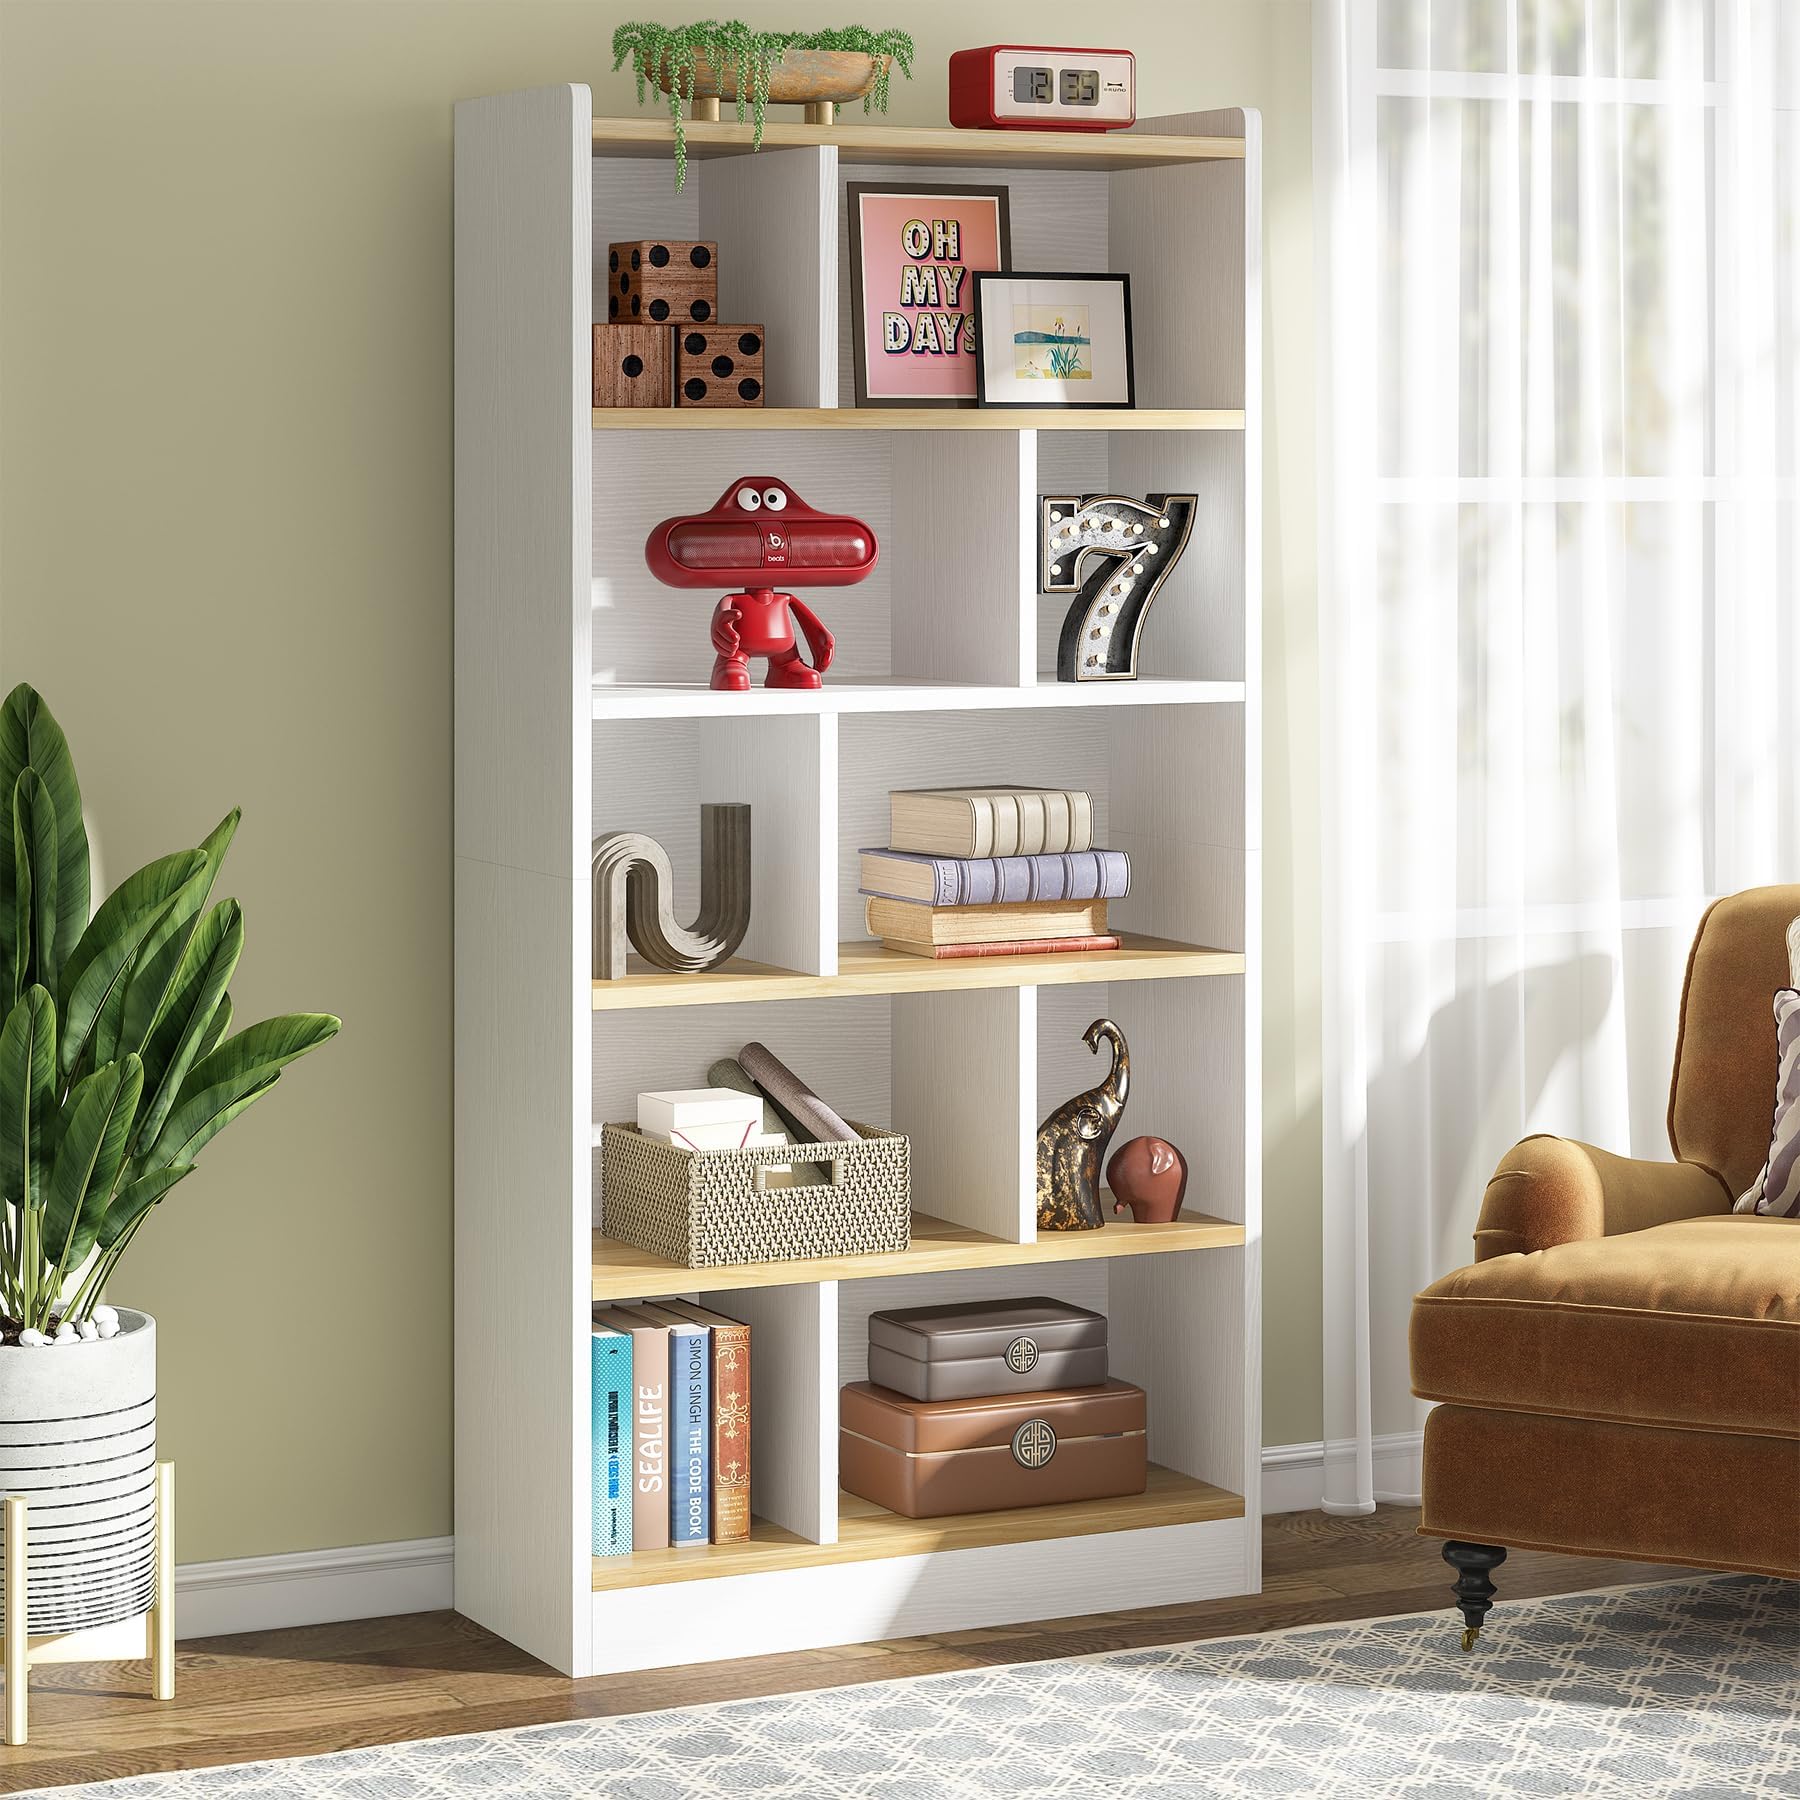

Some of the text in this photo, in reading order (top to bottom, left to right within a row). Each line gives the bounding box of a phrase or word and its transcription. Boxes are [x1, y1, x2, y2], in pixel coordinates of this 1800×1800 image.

[1030, 72, 1094, 100] 12 35
[901, 219, 961, 261] OH
[900, 265, 966, 307] MY
[1037, 494, 1198, 682] 7
[638, 1383, 663, 1493] SEALIFE
[689, 1338, 702, 1537] SIMON SINGH THE CODE BOOK
